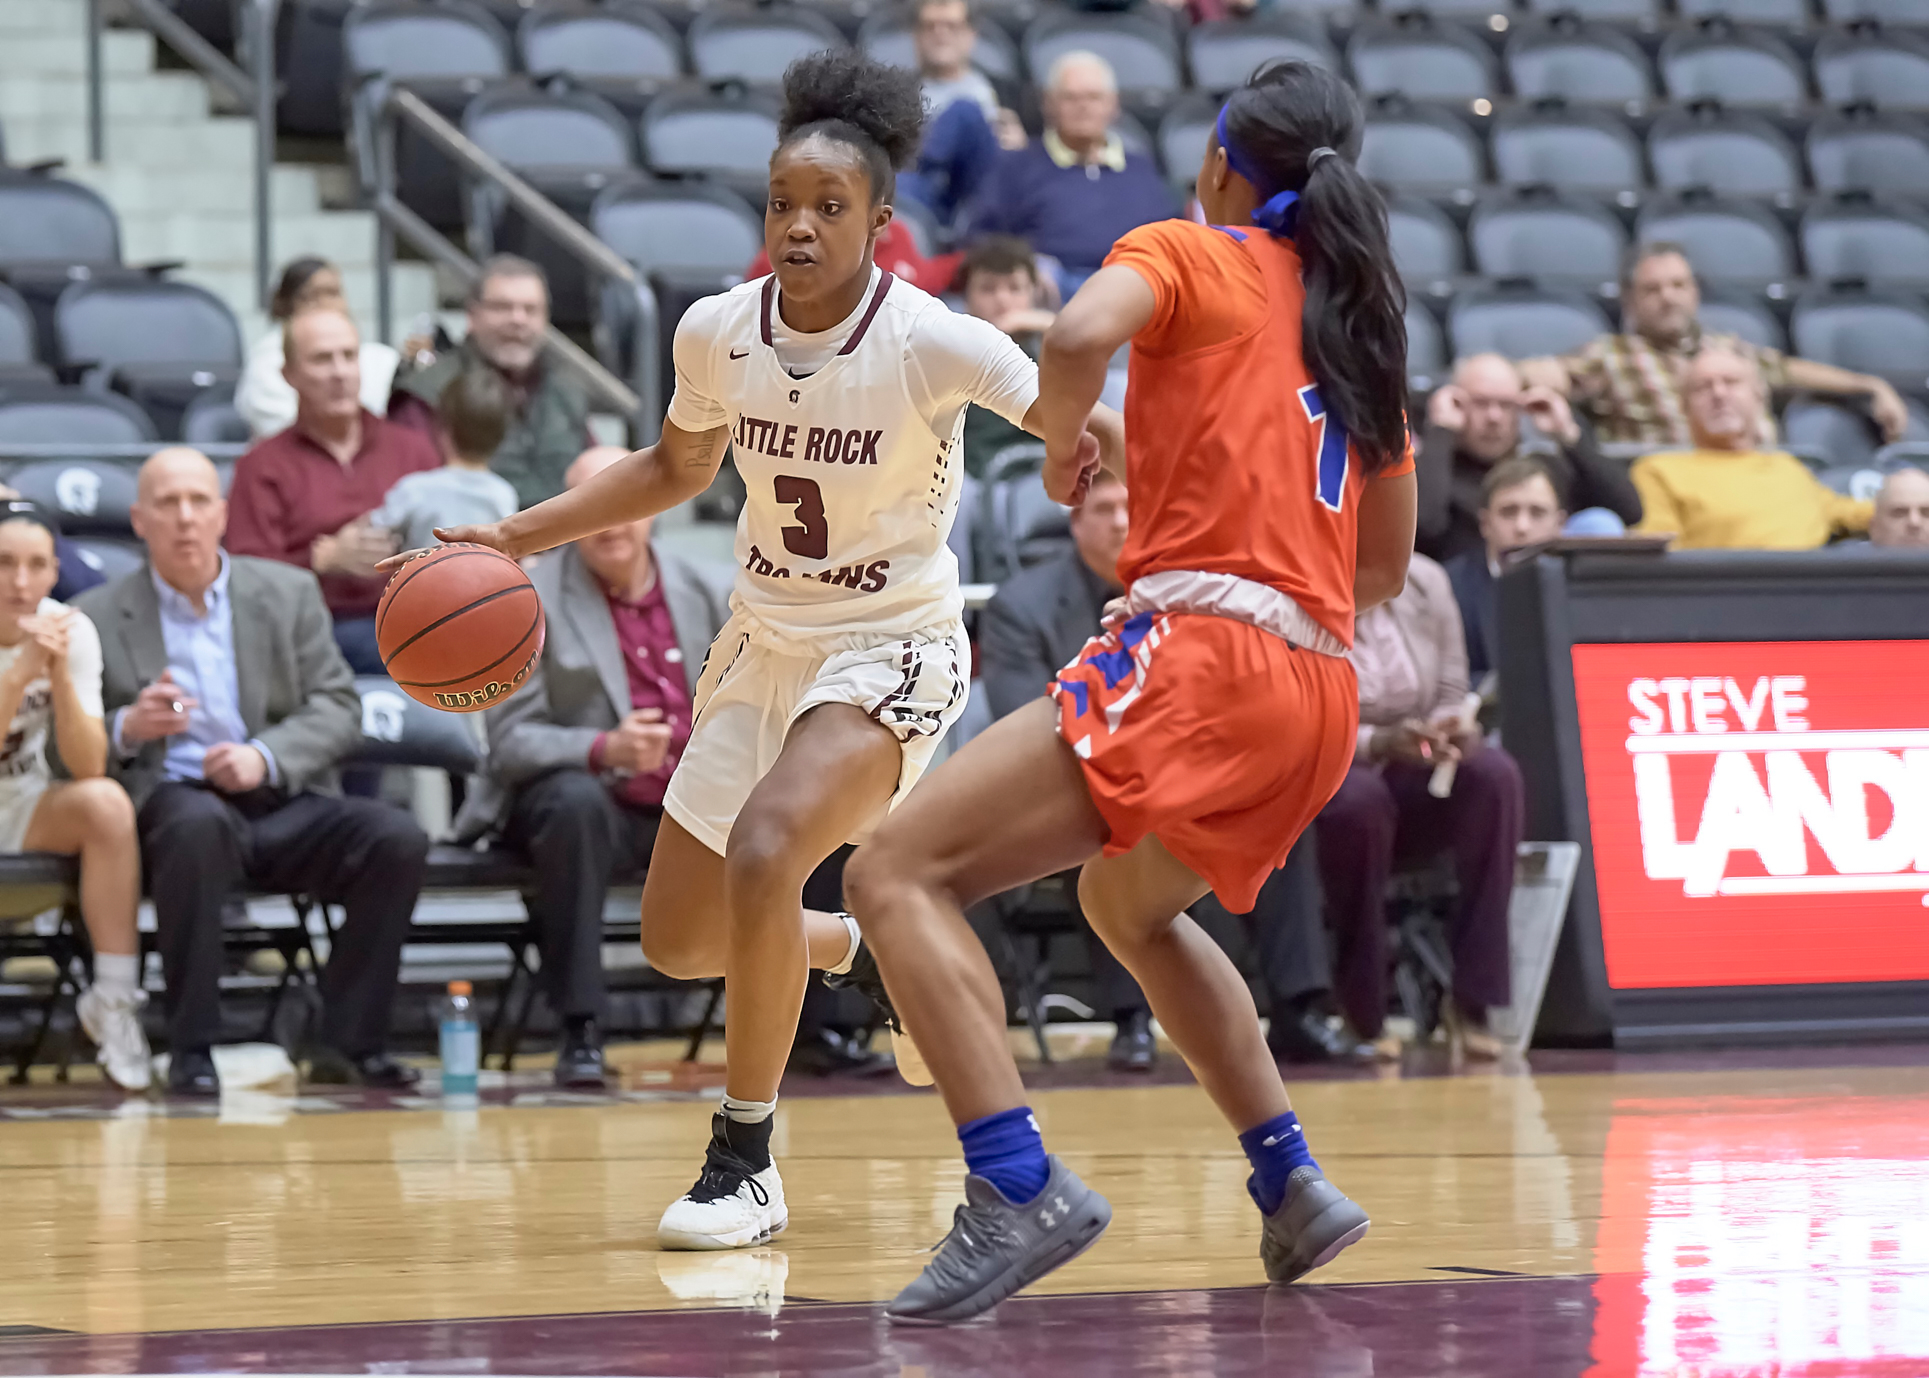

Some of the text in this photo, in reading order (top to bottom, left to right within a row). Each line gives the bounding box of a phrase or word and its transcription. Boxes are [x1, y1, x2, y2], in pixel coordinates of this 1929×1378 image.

[733, 412, 884, 465] ITTLE ROCK
[773, 474, 829, 560] 3
[745, 544, 890, 593] TRANS
[433, 648, 539, 708] Wilson
[1627, 674, 1811, 734] STEVE
[1632, 748, 1929, 897] LAND
